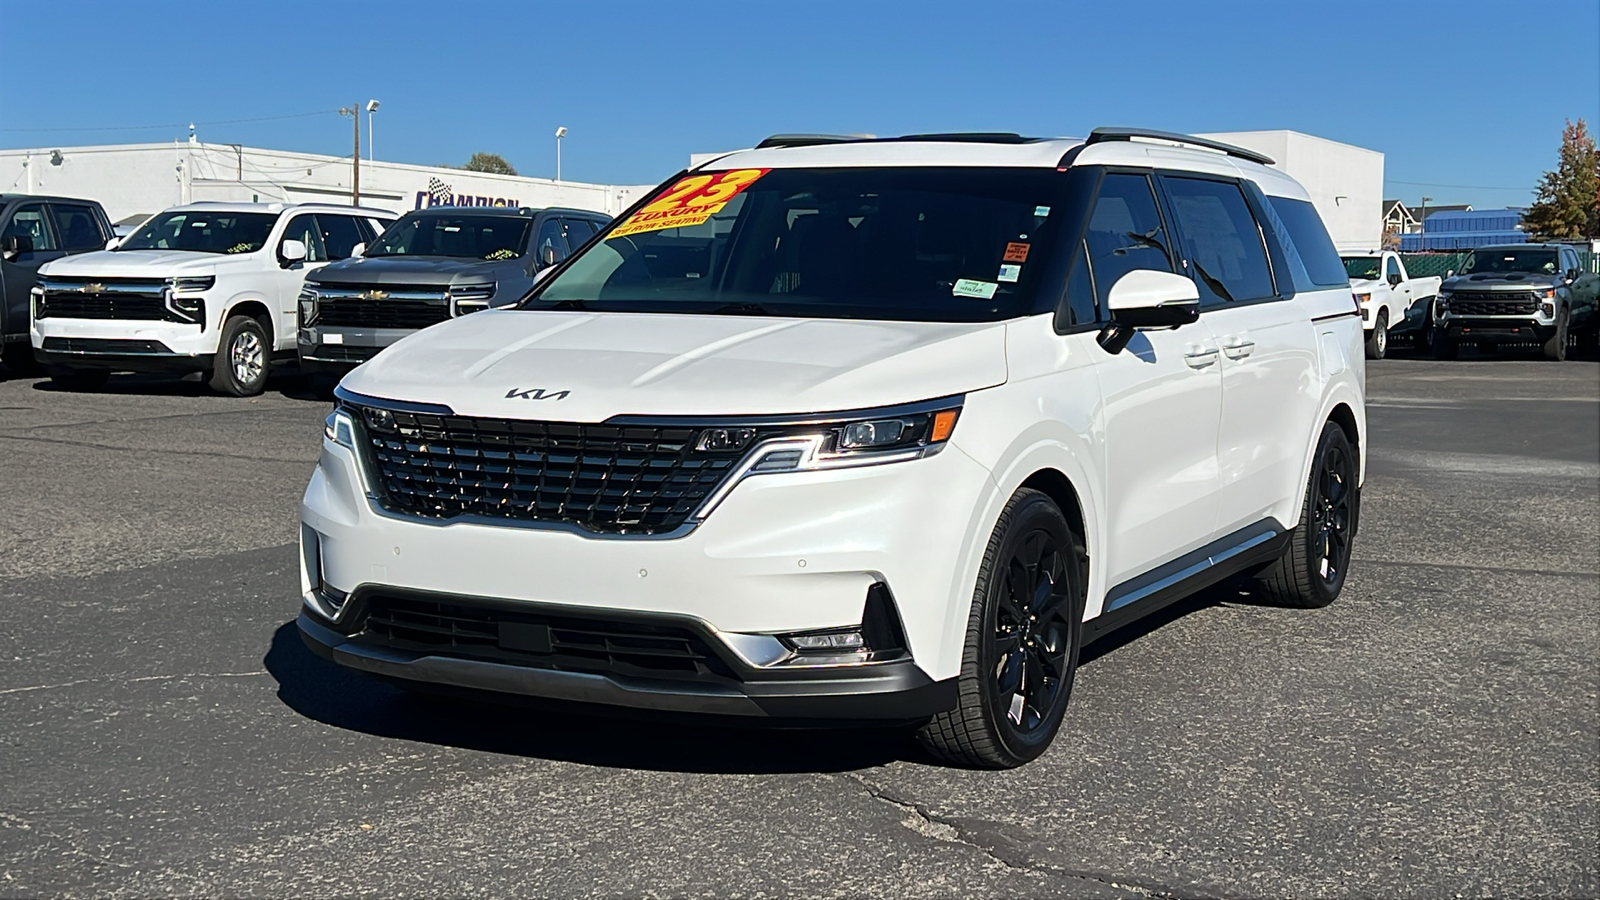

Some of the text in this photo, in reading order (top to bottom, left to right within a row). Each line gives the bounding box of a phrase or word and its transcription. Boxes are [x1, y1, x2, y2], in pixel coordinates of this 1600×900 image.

[641, 169, 762, 213] 23
[629, 204, 719, 224] LUXURY
[659, 215, 707, 227] SEATING
[504, 387, 571, 401] KIA
